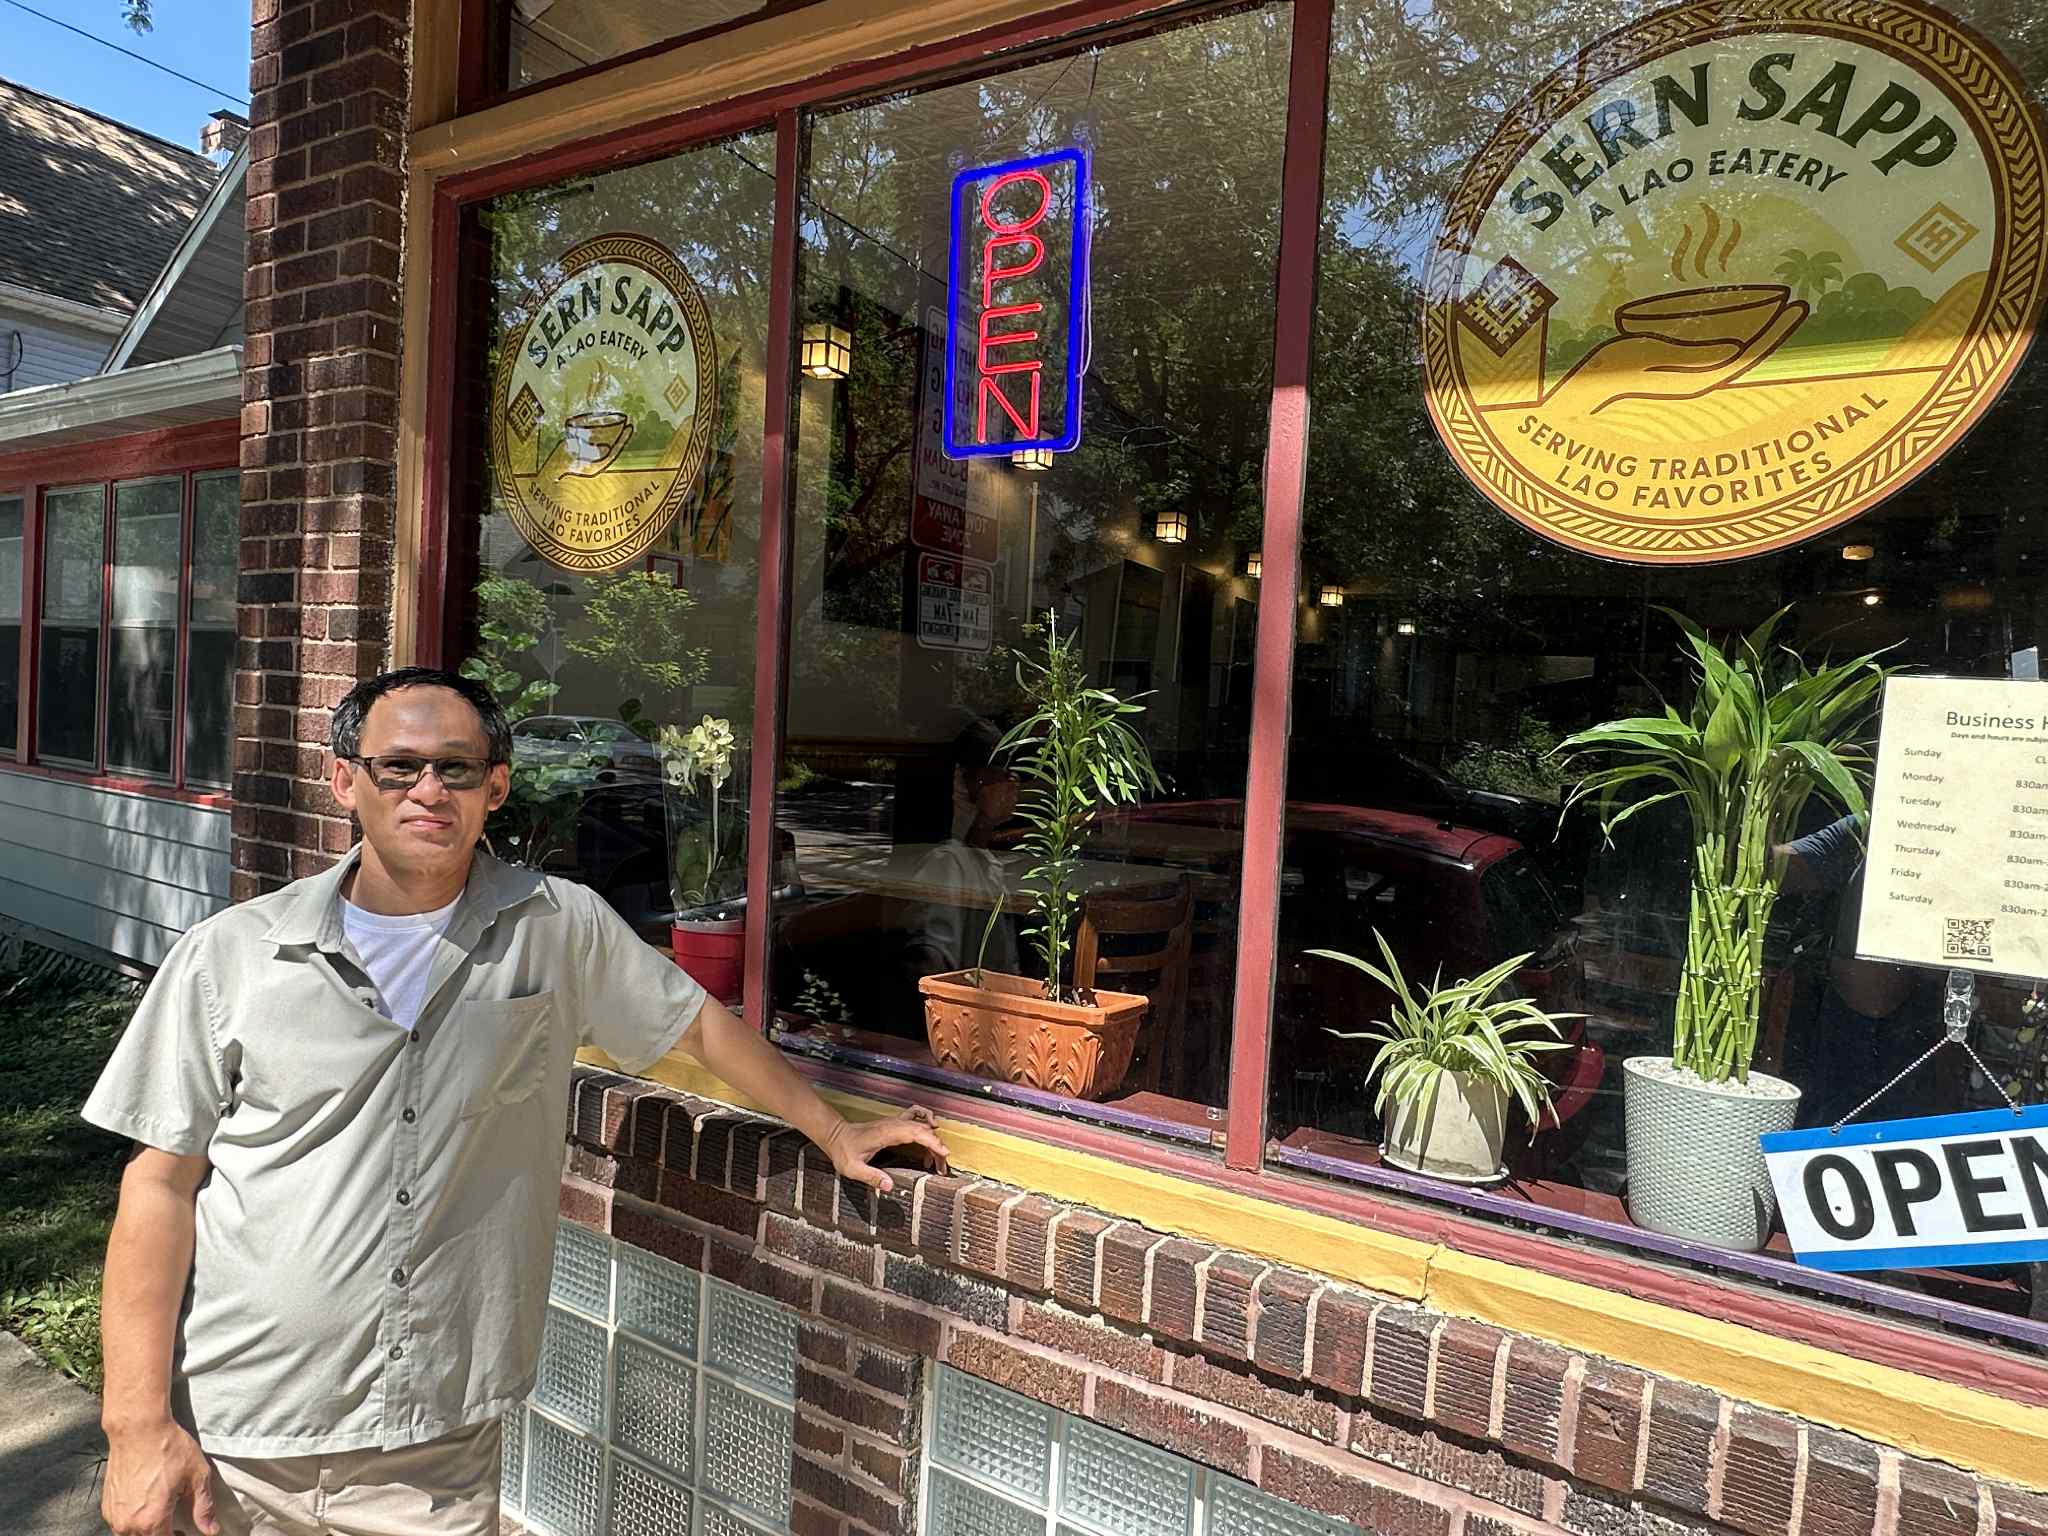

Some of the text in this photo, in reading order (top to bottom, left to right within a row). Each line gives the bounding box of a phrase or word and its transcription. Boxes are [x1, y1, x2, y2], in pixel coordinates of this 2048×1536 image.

[1510, 53, 1959, 232] SERN SAPP
[1588, 149, 1850, 228] A LAO EATERY
[976, 169, 1053, 444] OPEN
[528, 275, 686, 369] SERN SAPP
[556, 330, 649, 370] A LAO EATERY
[1517, 391, 1889, 481] SERVING TRADITIONAL
[1555, 451, 1833, 510] LAO FAVORITES
[528, 480, 661, 527] SERVING TRADITIONAL
[542, 514, 641, 544] LAO FAVORITES
[1946, 711, 2034, 729] Business
[1904, 747, 1942, 759] Sunday
[1902, 772, 1944, 784] Monday
[1900, 796, 1941, 808] Tuesday
[1897, 820, 1957, 834] Wednesday
[1894, 844, 1941, 857] Thursday
[1890, 867, 2048, 892] Friday 830am-2
[1889, 892, 2048, 917] Saturday 830am-2
